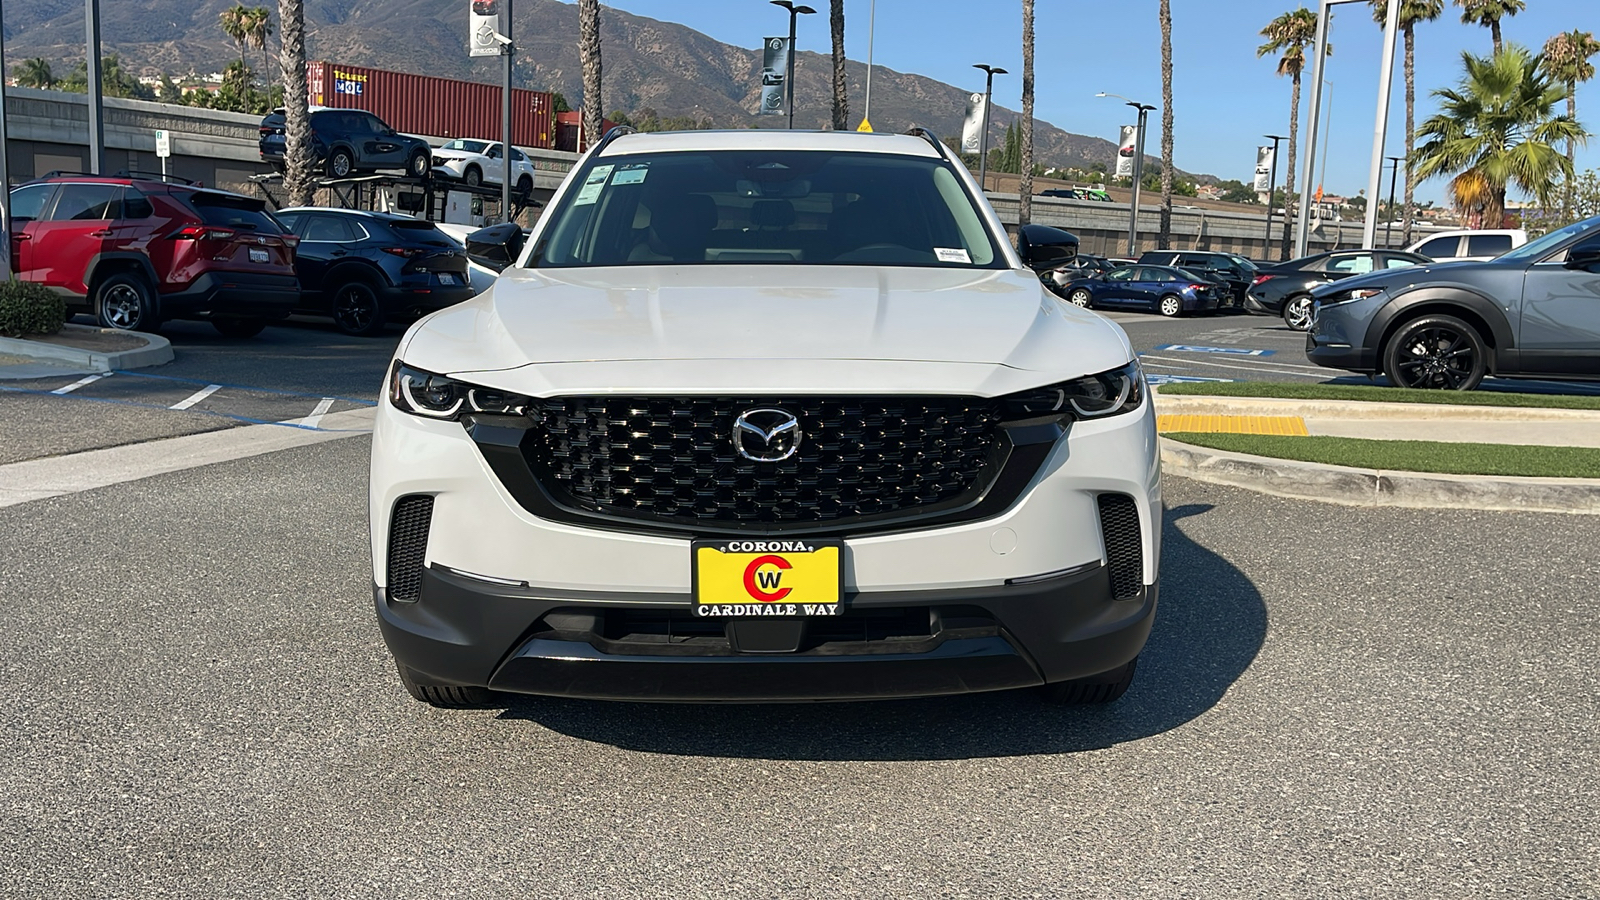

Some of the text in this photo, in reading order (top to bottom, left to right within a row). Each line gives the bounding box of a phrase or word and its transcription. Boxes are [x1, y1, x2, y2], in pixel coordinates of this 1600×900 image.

[336, 81, 363, 94] MOL
[728, 541, 807, 552] CORONA
[697, 604, 838, 616] CARDINALE WAY
